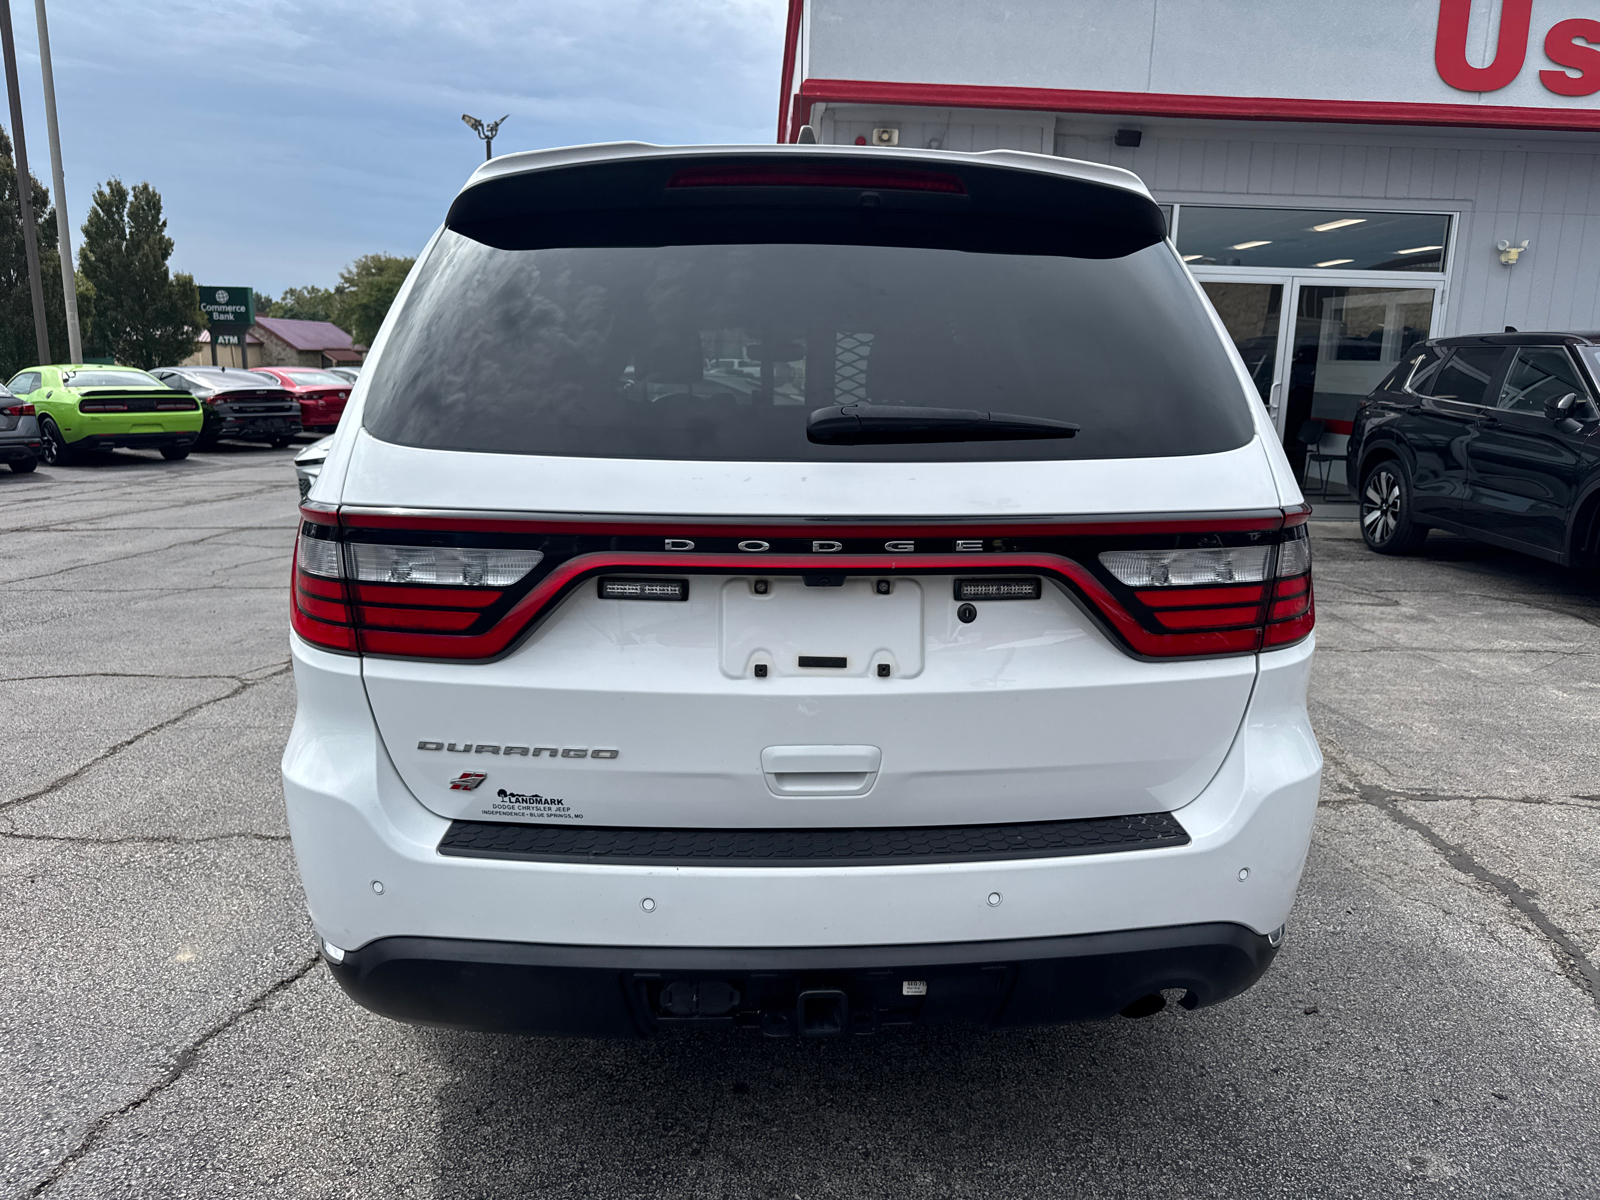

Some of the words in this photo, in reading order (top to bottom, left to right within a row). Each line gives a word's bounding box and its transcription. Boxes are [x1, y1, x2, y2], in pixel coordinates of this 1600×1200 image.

[200, 303, 246, 313] Commerce
[213, 312, 235, 320] Bank
[217, 335, 239, 344] ATM
[665, 539, 984, 552] DODGE
[417, 740, 620, 759] DURANGO
[508, 797, 564, 806] LANDMARK
